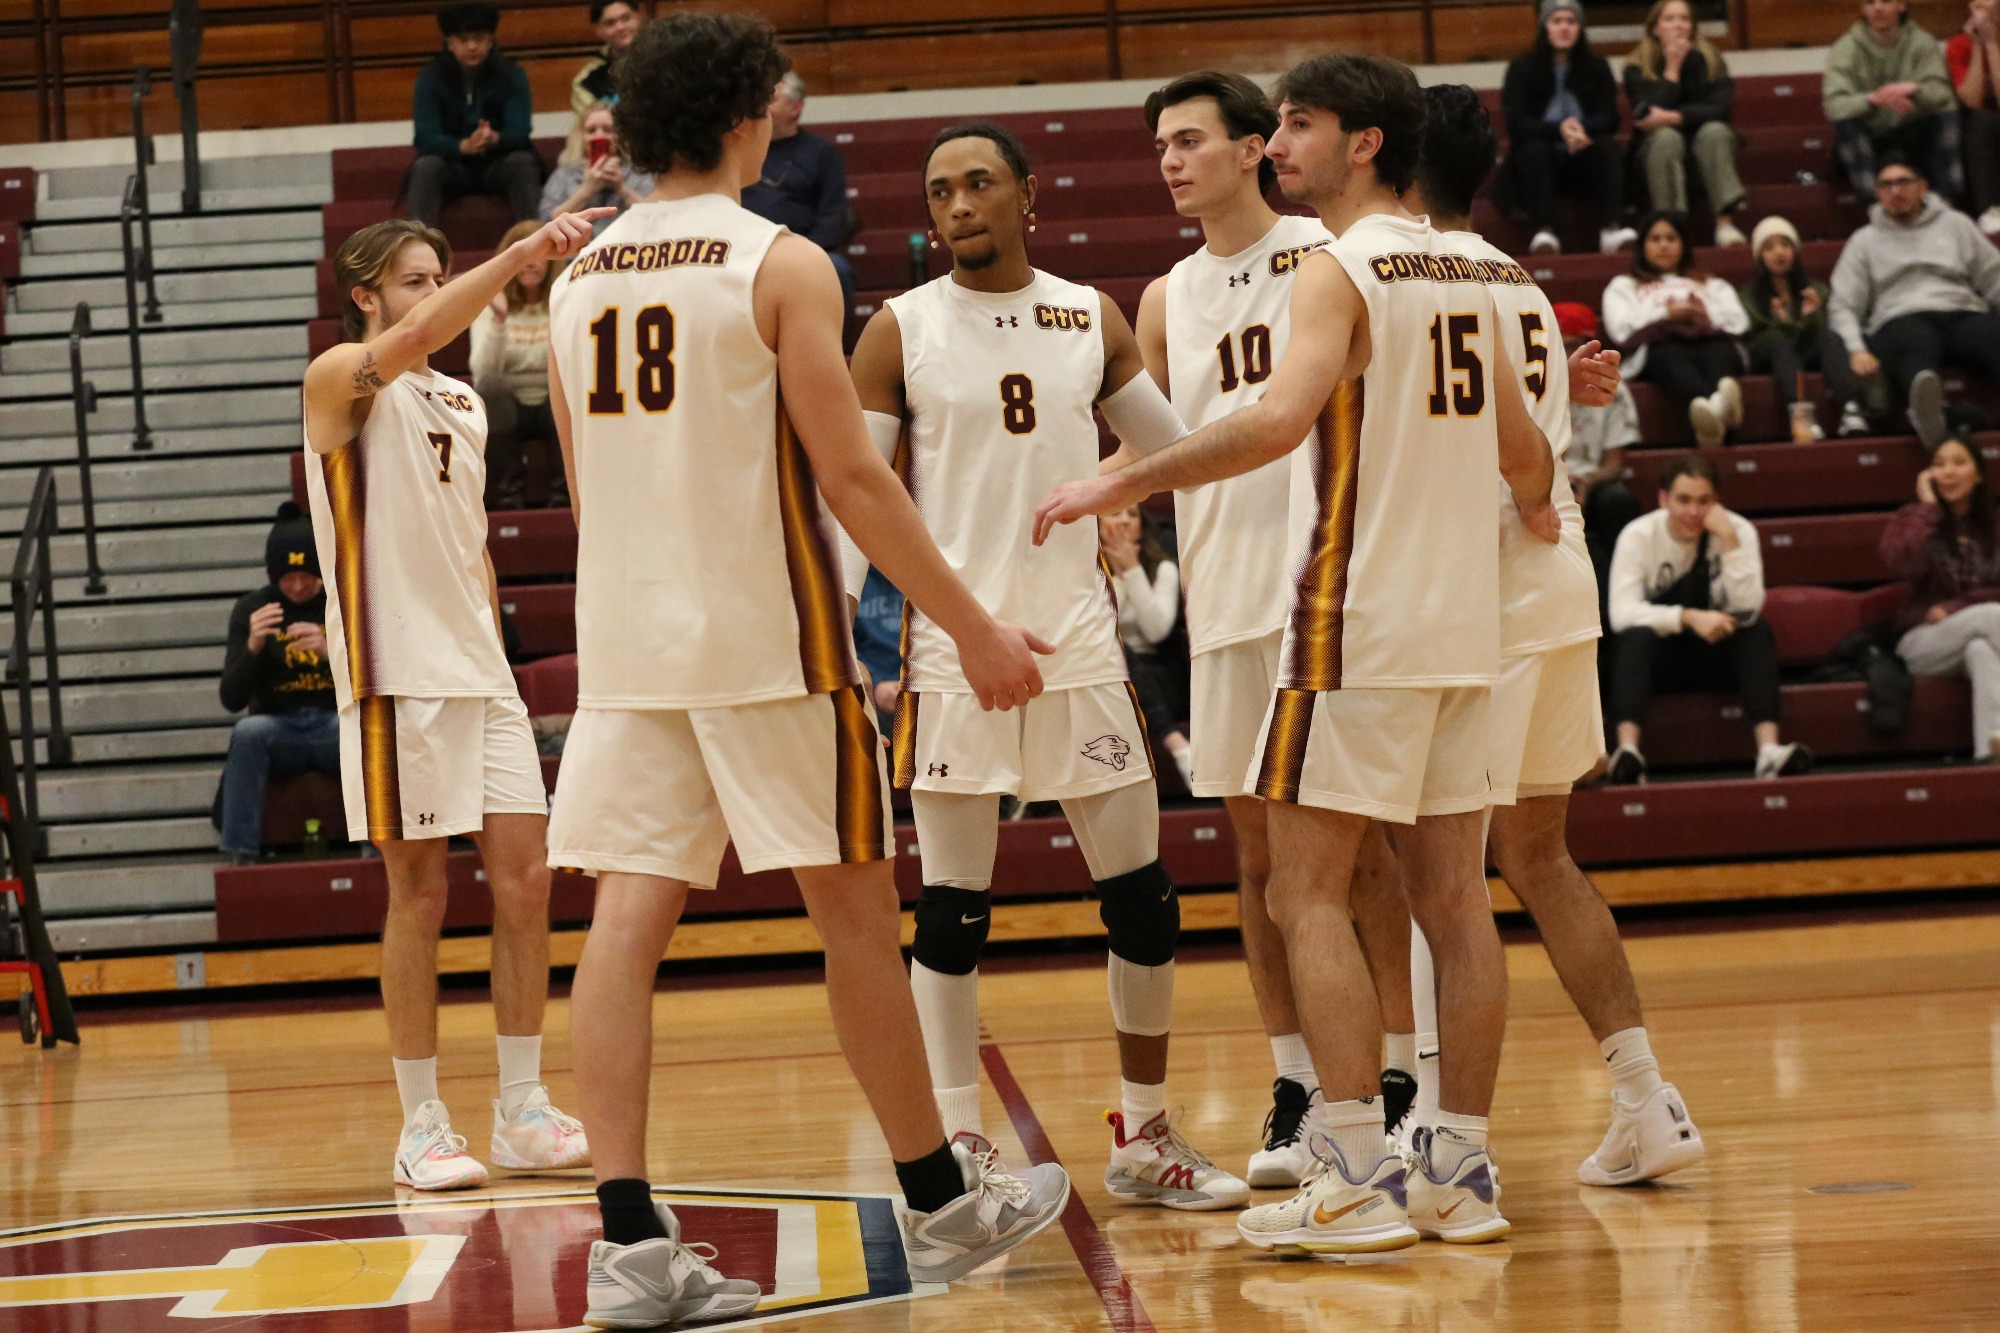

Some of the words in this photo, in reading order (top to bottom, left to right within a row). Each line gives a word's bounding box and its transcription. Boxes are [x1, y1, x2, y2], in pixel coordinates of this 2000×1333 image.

[568, 237, 732, 284] CONCORDIA
[1269, 239, 1332, 277] CU
[1033, 302, 1092, 332] CUC
[587, 302, 676, 416] 18
[1216, 322, 1272, 394] 10
[1427, 311, 1485, 418] 15
[1518, 311, 1548, 404] 5
[999, 373, 1037, 435] 8
[427, 431, 453, 484] 7
[288, 552, 305, 566] M
